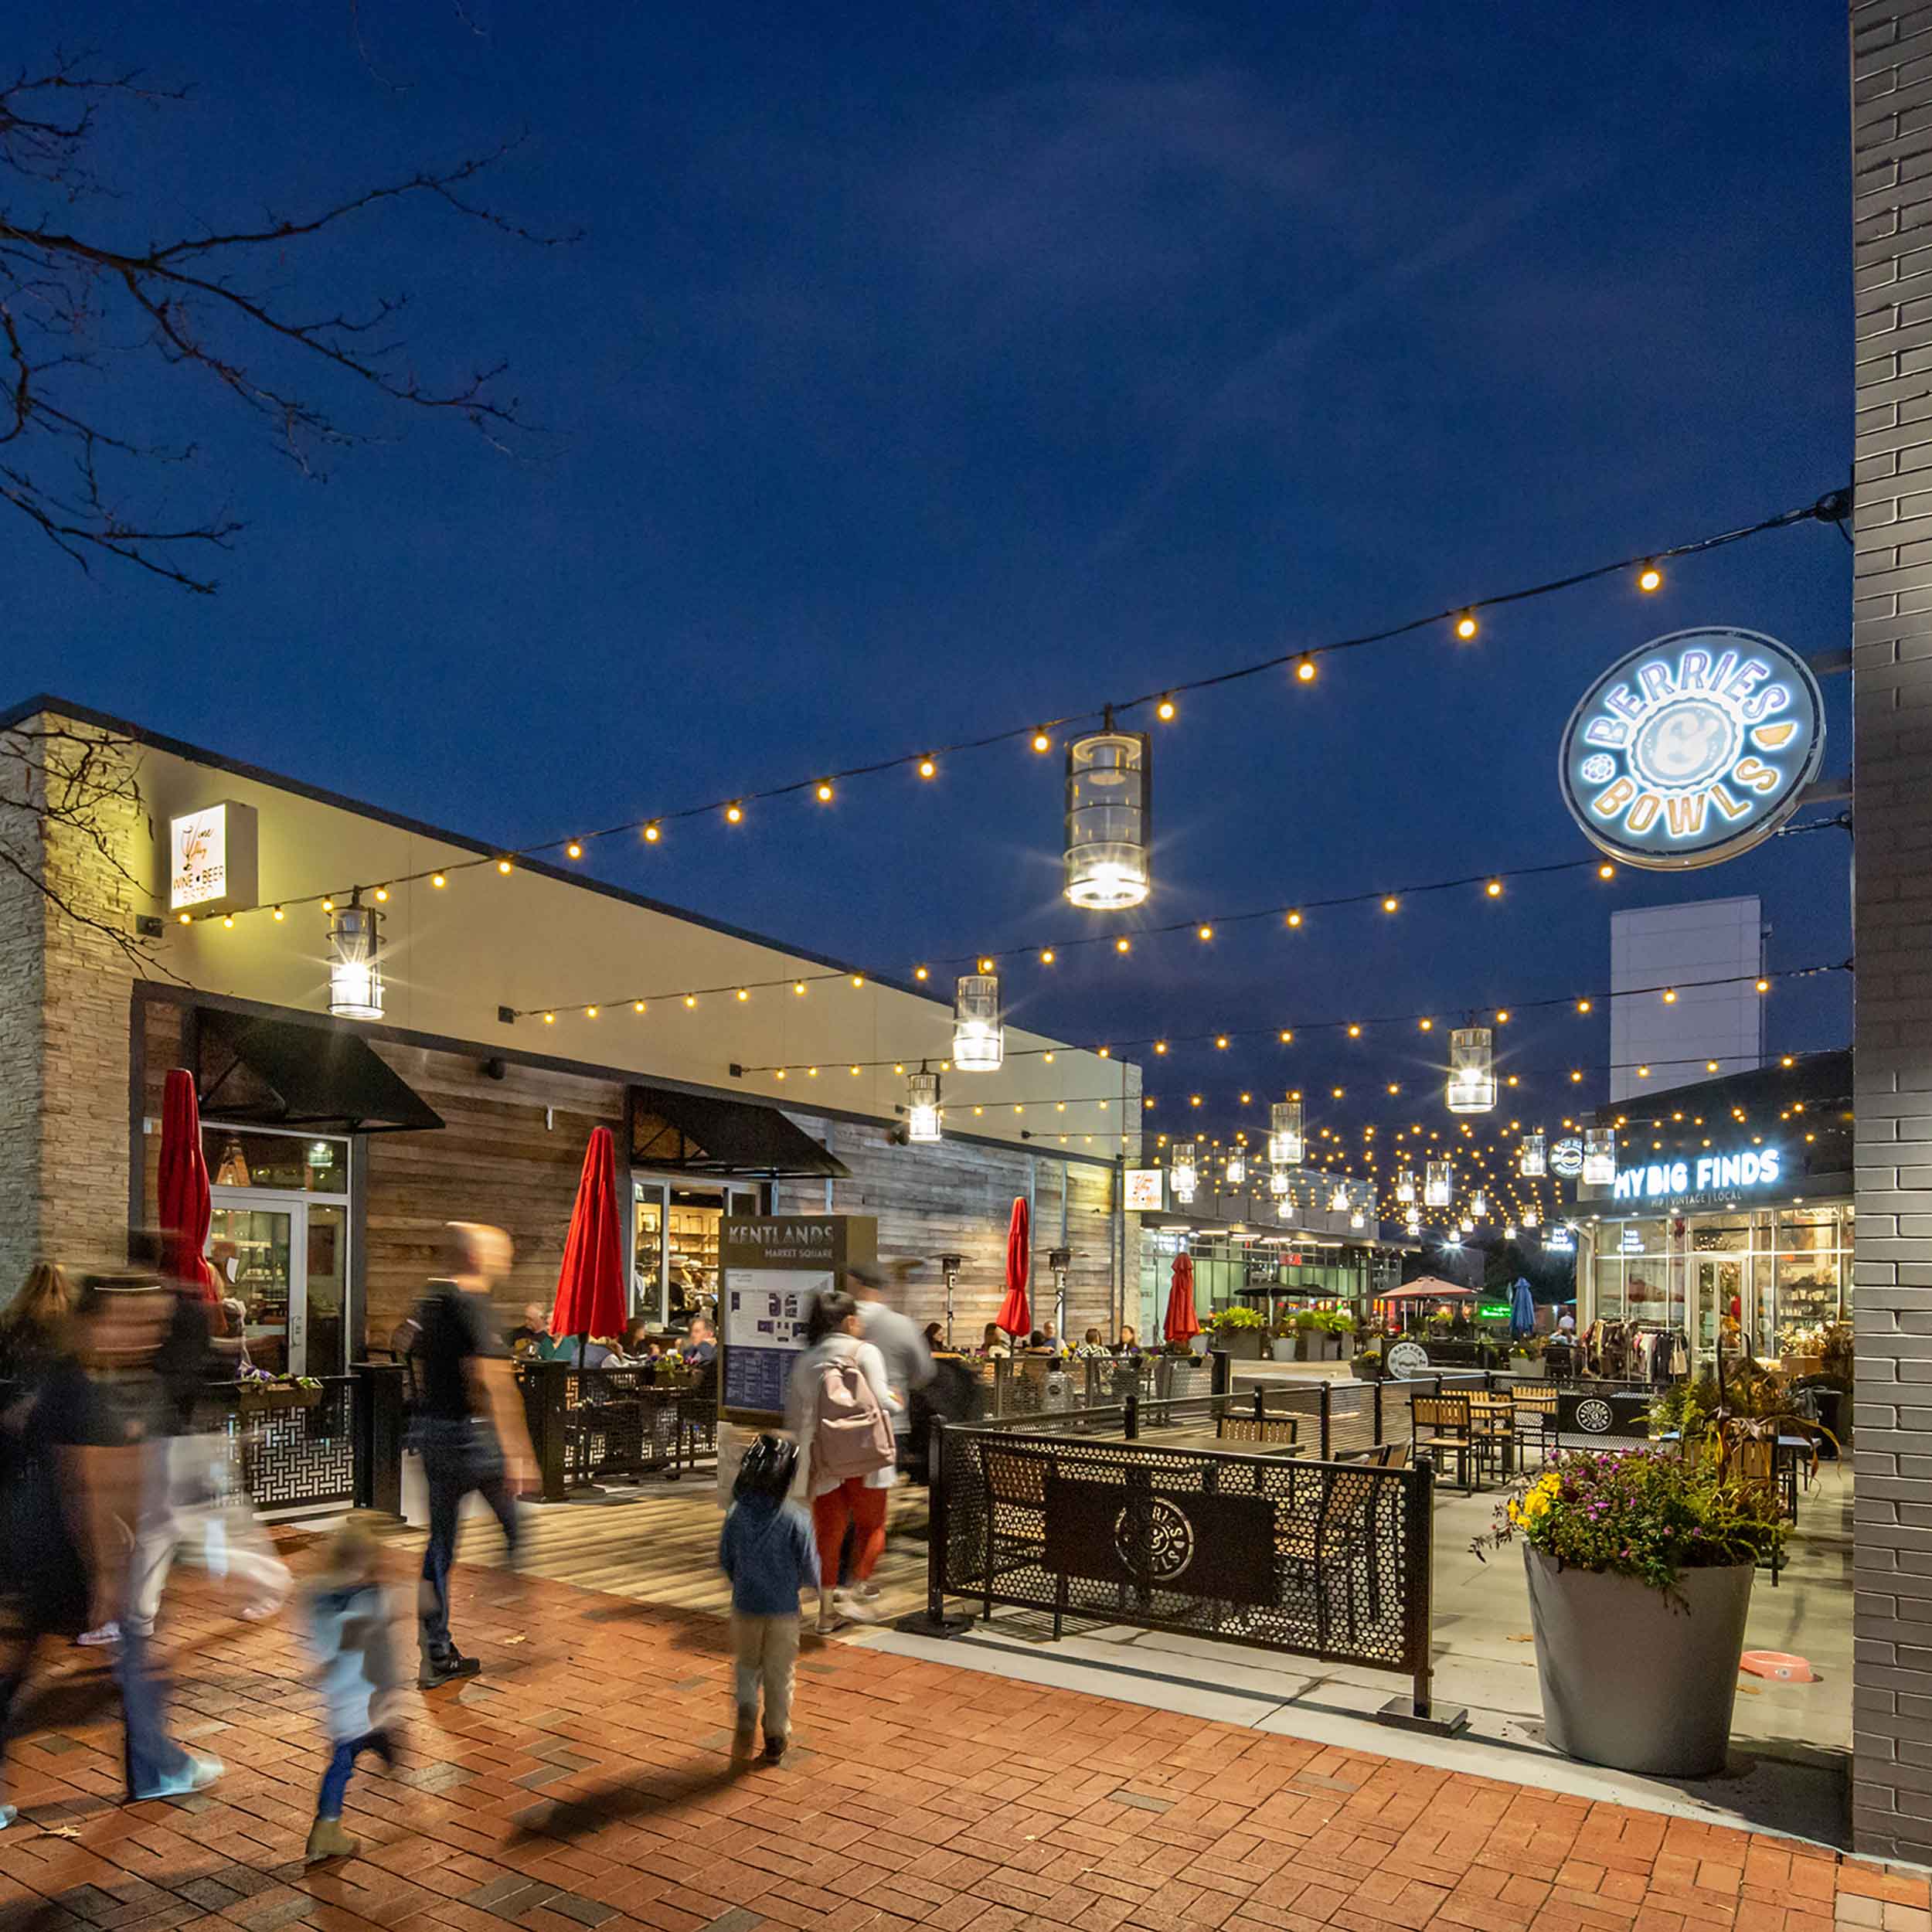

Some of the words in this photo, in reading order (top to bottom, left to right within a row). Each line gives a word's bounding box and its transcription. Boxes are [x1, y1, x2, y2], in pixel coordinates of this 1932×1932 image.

[1585, 650, 1788, 747] BERRIES
[1592, 757, 1779, 836] BOWLS
[1614, 1168, 1645, 1199] MY
[1647, 1162, 1688, 1196] BIG
[1696, 1148, 1780, 1190] FINDS
[1671, 1192, 1705, 1206] VINTAGE
[1713, 1191, 1741, 1202] LOCAL
[728, 1225, 835, 1244] KENTLANDS
[764, 1248, 797, 1258] MARKET
[799, 1248, 834, 1259] SQUARE
